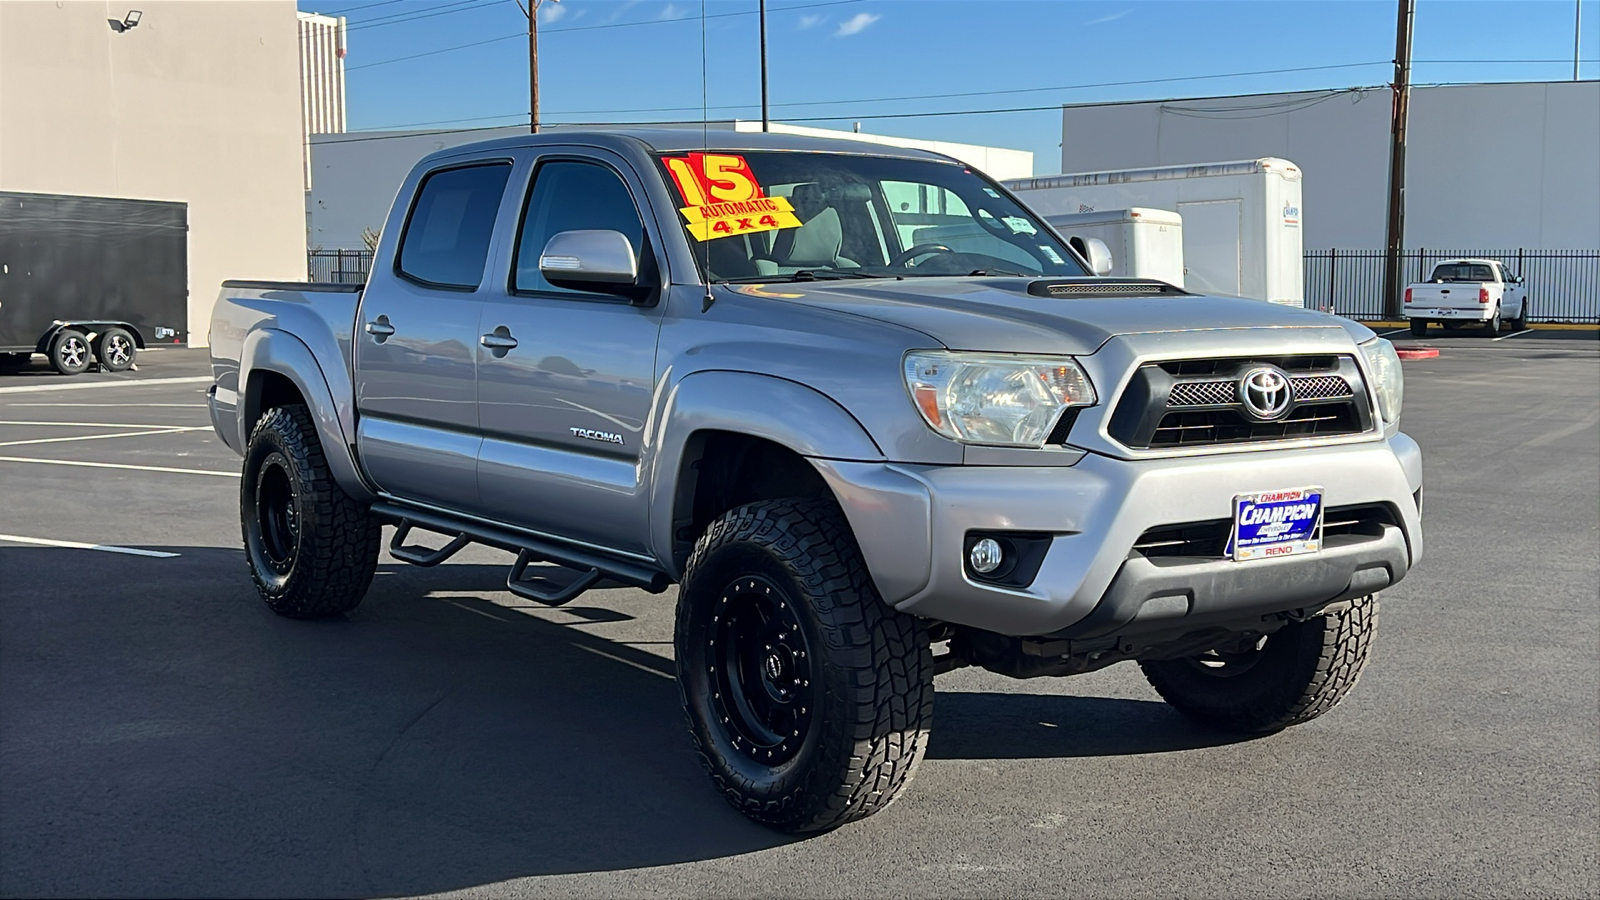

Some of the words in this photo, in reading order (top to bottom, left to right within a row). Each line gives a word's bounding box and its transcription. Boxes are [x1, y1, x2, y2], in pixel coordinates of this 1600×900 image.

[669, 155, 754, 206] 15
[699, 199, 778, 218] AUTOMATIC
[569, 427, 625, 445] TACOMA
[1260, 491, 1301, 503] CHAMPION
[1240, 503, 1317, 525] CHAMPION
[1260, 524, 1290, 533] CHEVROLET
[1265, 546, 1293, 556] RENO
